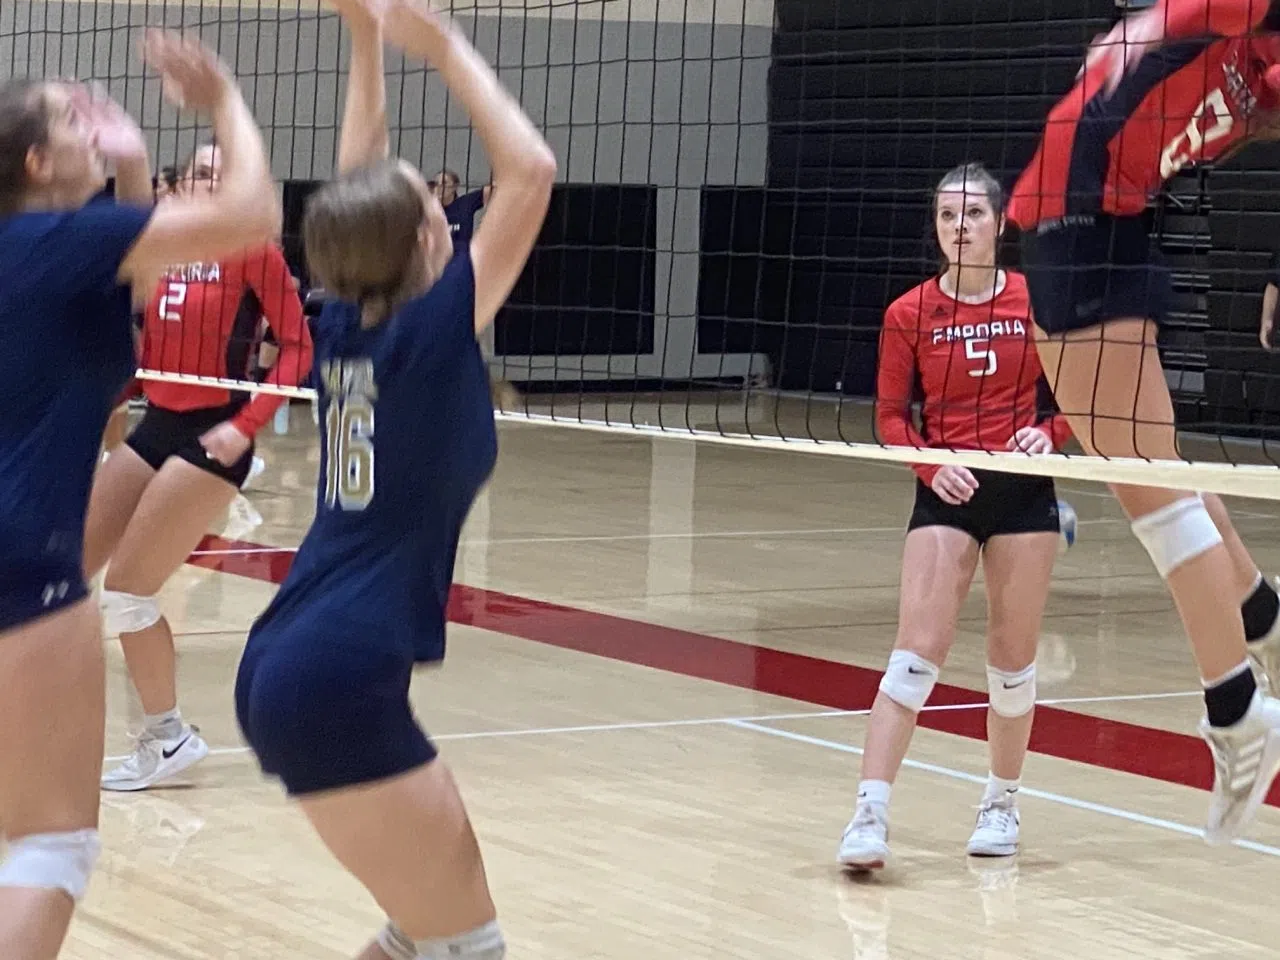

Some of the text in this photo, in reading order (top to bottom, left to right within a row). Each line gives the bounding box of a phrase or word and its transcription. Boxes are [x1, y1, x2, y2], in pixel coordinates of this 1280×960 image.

[159, 283, 187, 321] 2
[965, 338, 997, 377] 5
[325, 397, 375, 511] 16
